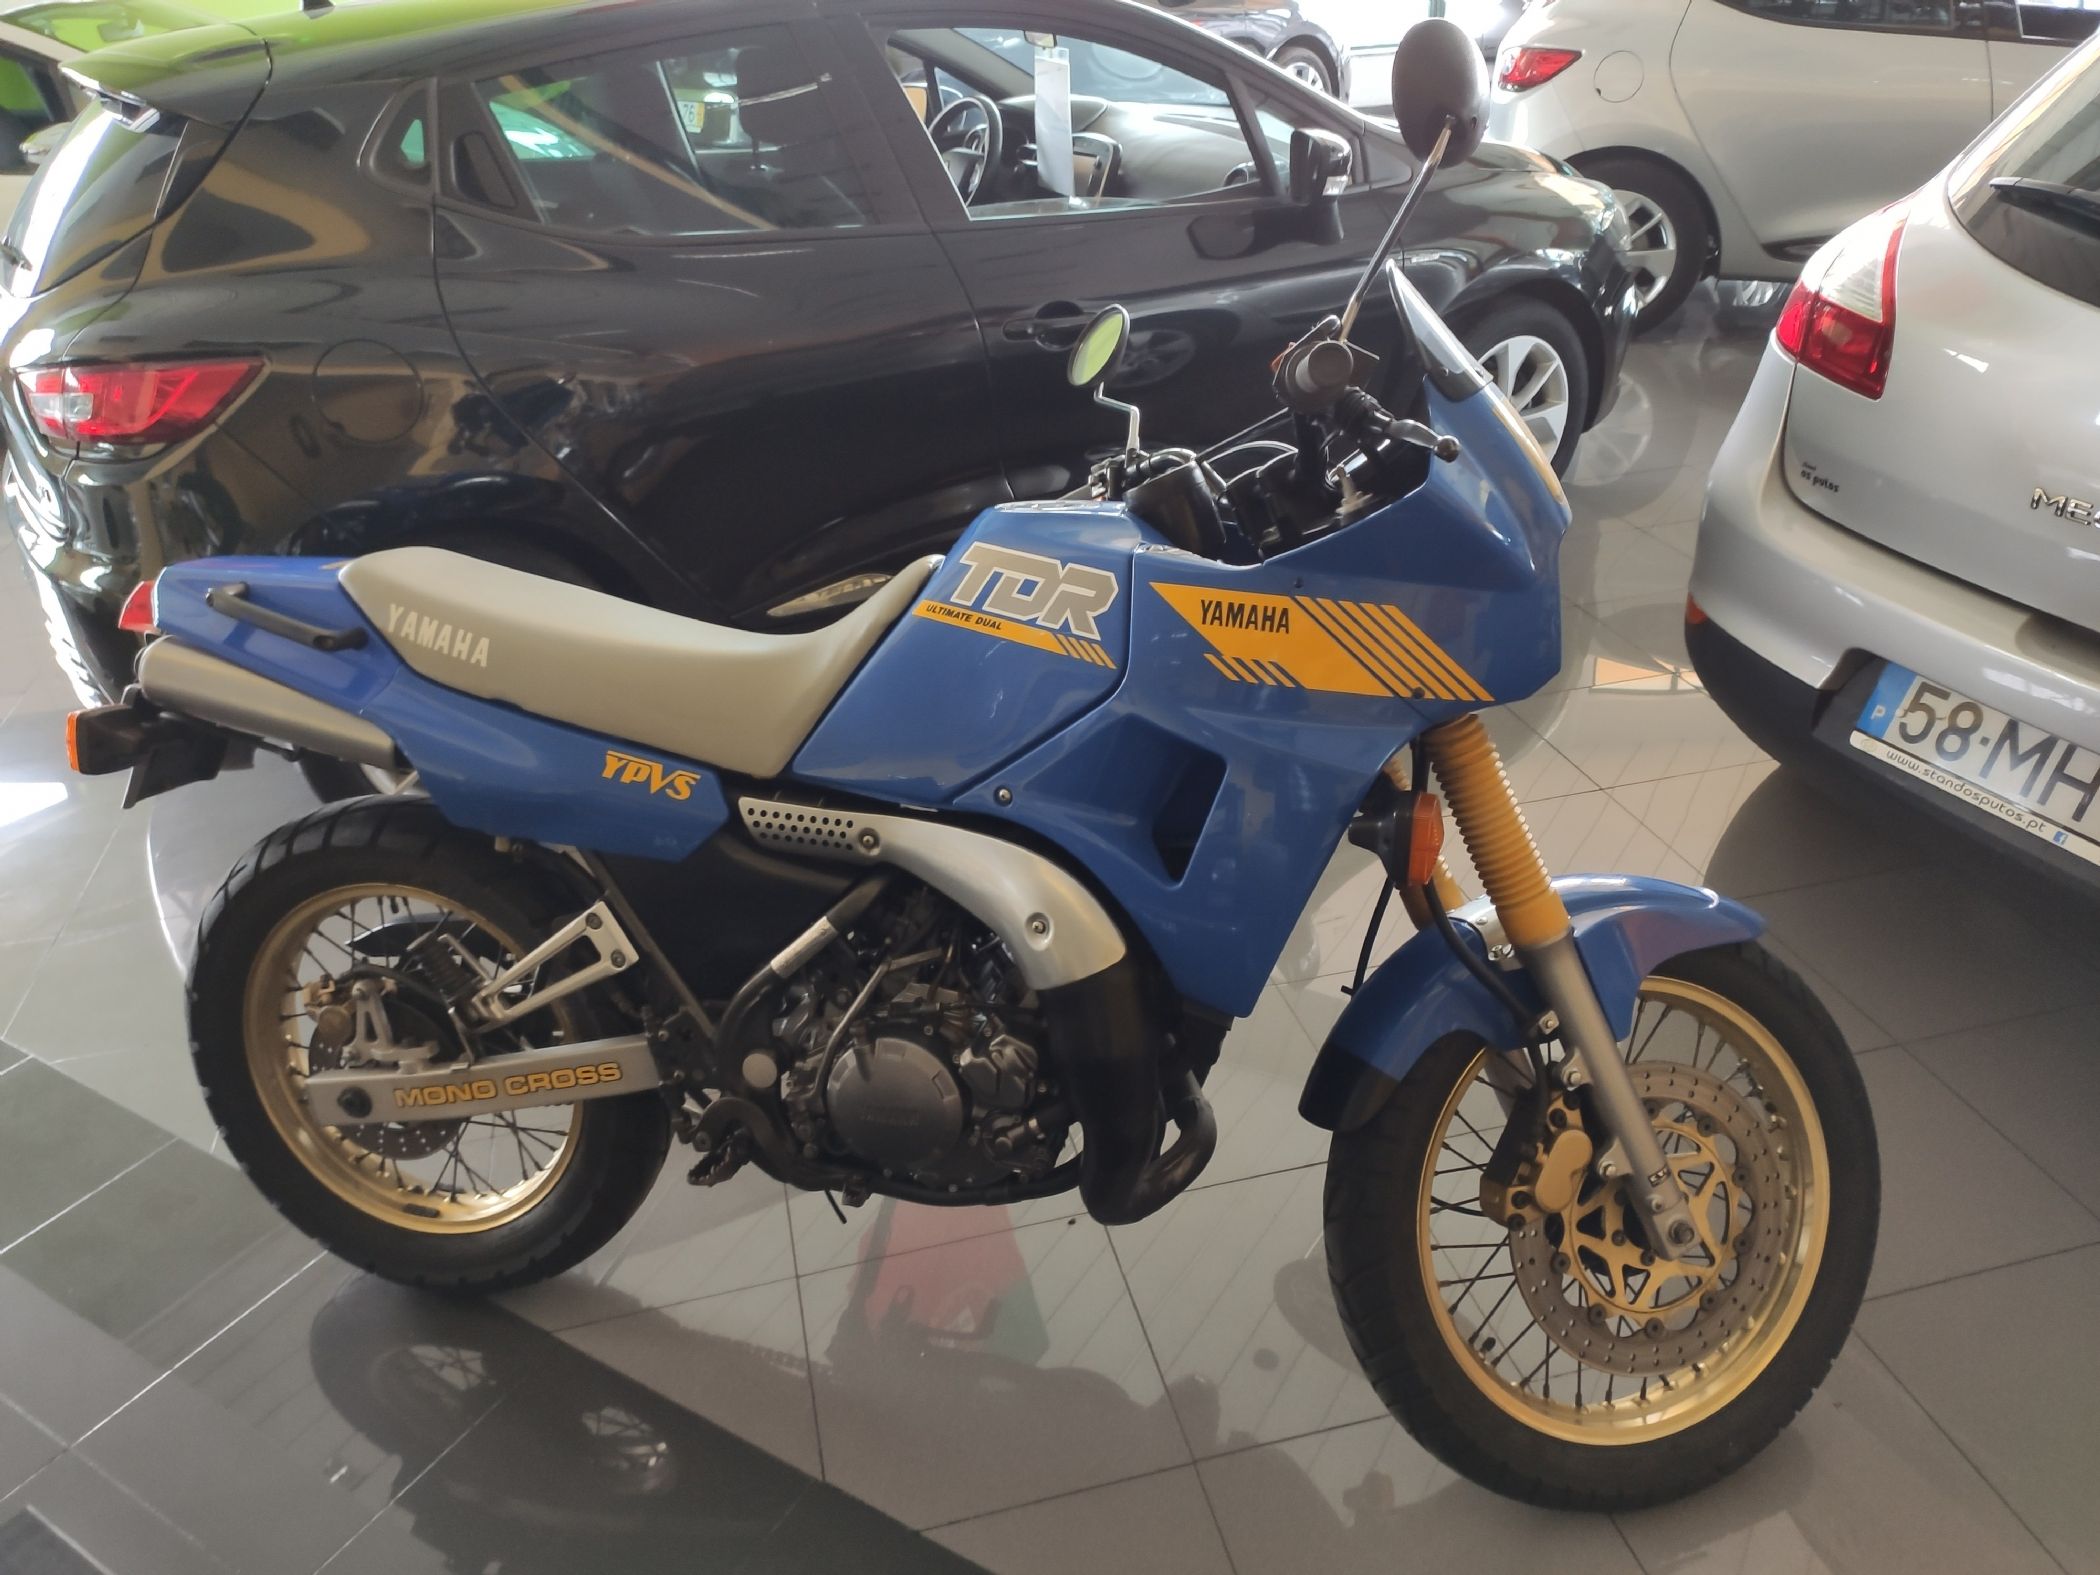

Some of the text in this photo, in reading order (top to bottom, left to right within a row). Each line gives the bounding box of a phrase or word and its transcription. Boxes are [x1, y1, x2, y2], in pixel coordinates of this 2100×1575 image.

[951, 541, 1119, 641] TDR
[386, 604, 490, 668] YAMAHA
[926, 604, 1002, 630] ULTIMATE DUAL
[1200, 599, 1290, 634] YAMAHA
[1870, 705, 1886, 721] P
[602, 750, 701, 801] YPVS
[1885, 750, 2047, 833] www.standosputos.pt
[393, 1061, 622, 1108] MONO CROSS
